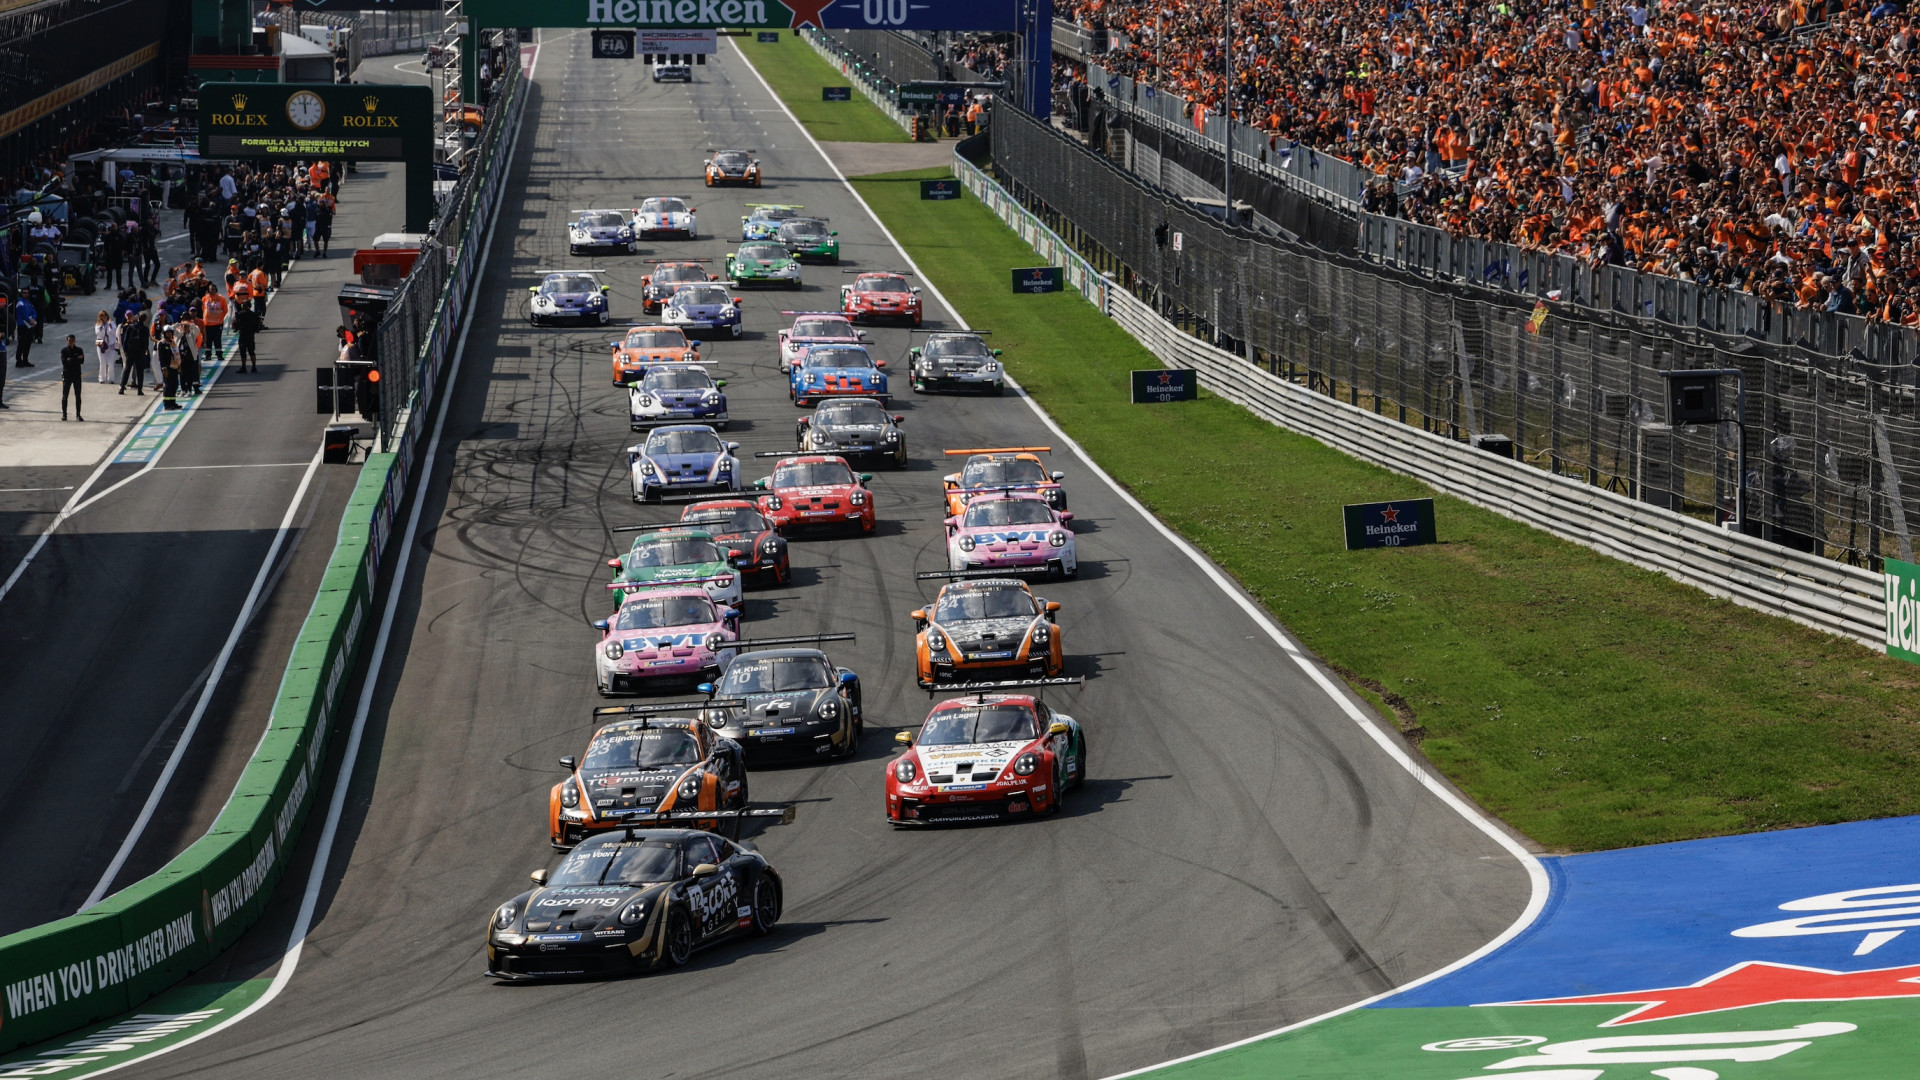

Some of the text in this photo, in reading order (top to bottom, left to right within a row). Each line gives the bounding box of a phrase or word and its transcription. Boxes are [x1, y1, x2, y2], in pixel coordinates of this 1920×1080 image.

[587, 0, 767, 24] Heineken
[211, 114, 268, 126] ROLEX
[343, 116, 399, 127] ROLEX
[1023, 279, 1052, 287] Heineken
[1146, 385, 1184, 393] Heineken
[1365, 523, 1417, 536] Heineken
[974, 531, 1050, 545] BWT
[634, 550, 650, 560] 16
[949, 580, 1022, 589] Thrminon
[938, 599, 958, 612] 24
[620, 613, 630, 623] 2
[623, 633, 708, 651] BWT
[732, 665, 768, 675] M.Klein
[730, 672, 751, 685] 10
[953, 711, 979, 719] Lagen
[926, 722, 938, 735] 9
[587, 743, 611, 758] 23
[929, 750, 983, 760] VINK
[593, 769, 676, 778] uniserver
[587, 776, 676, 786] Thrminon
[679, 809, 780, 817] BRACET
[562, 860, 585, 875] 12
[211, 888, 231, 927] WHEN
[229, 875, 243, 912] YOU
[536, 897, 620, 907] looping
[693, 892, 703, 909] 12
[701, 870, 738, 922] SCORE
[701, 896, 739, 937] AGENCY
[6, 911, 196, 1019] WHEN YOU DRIVE NEVER DRINK
